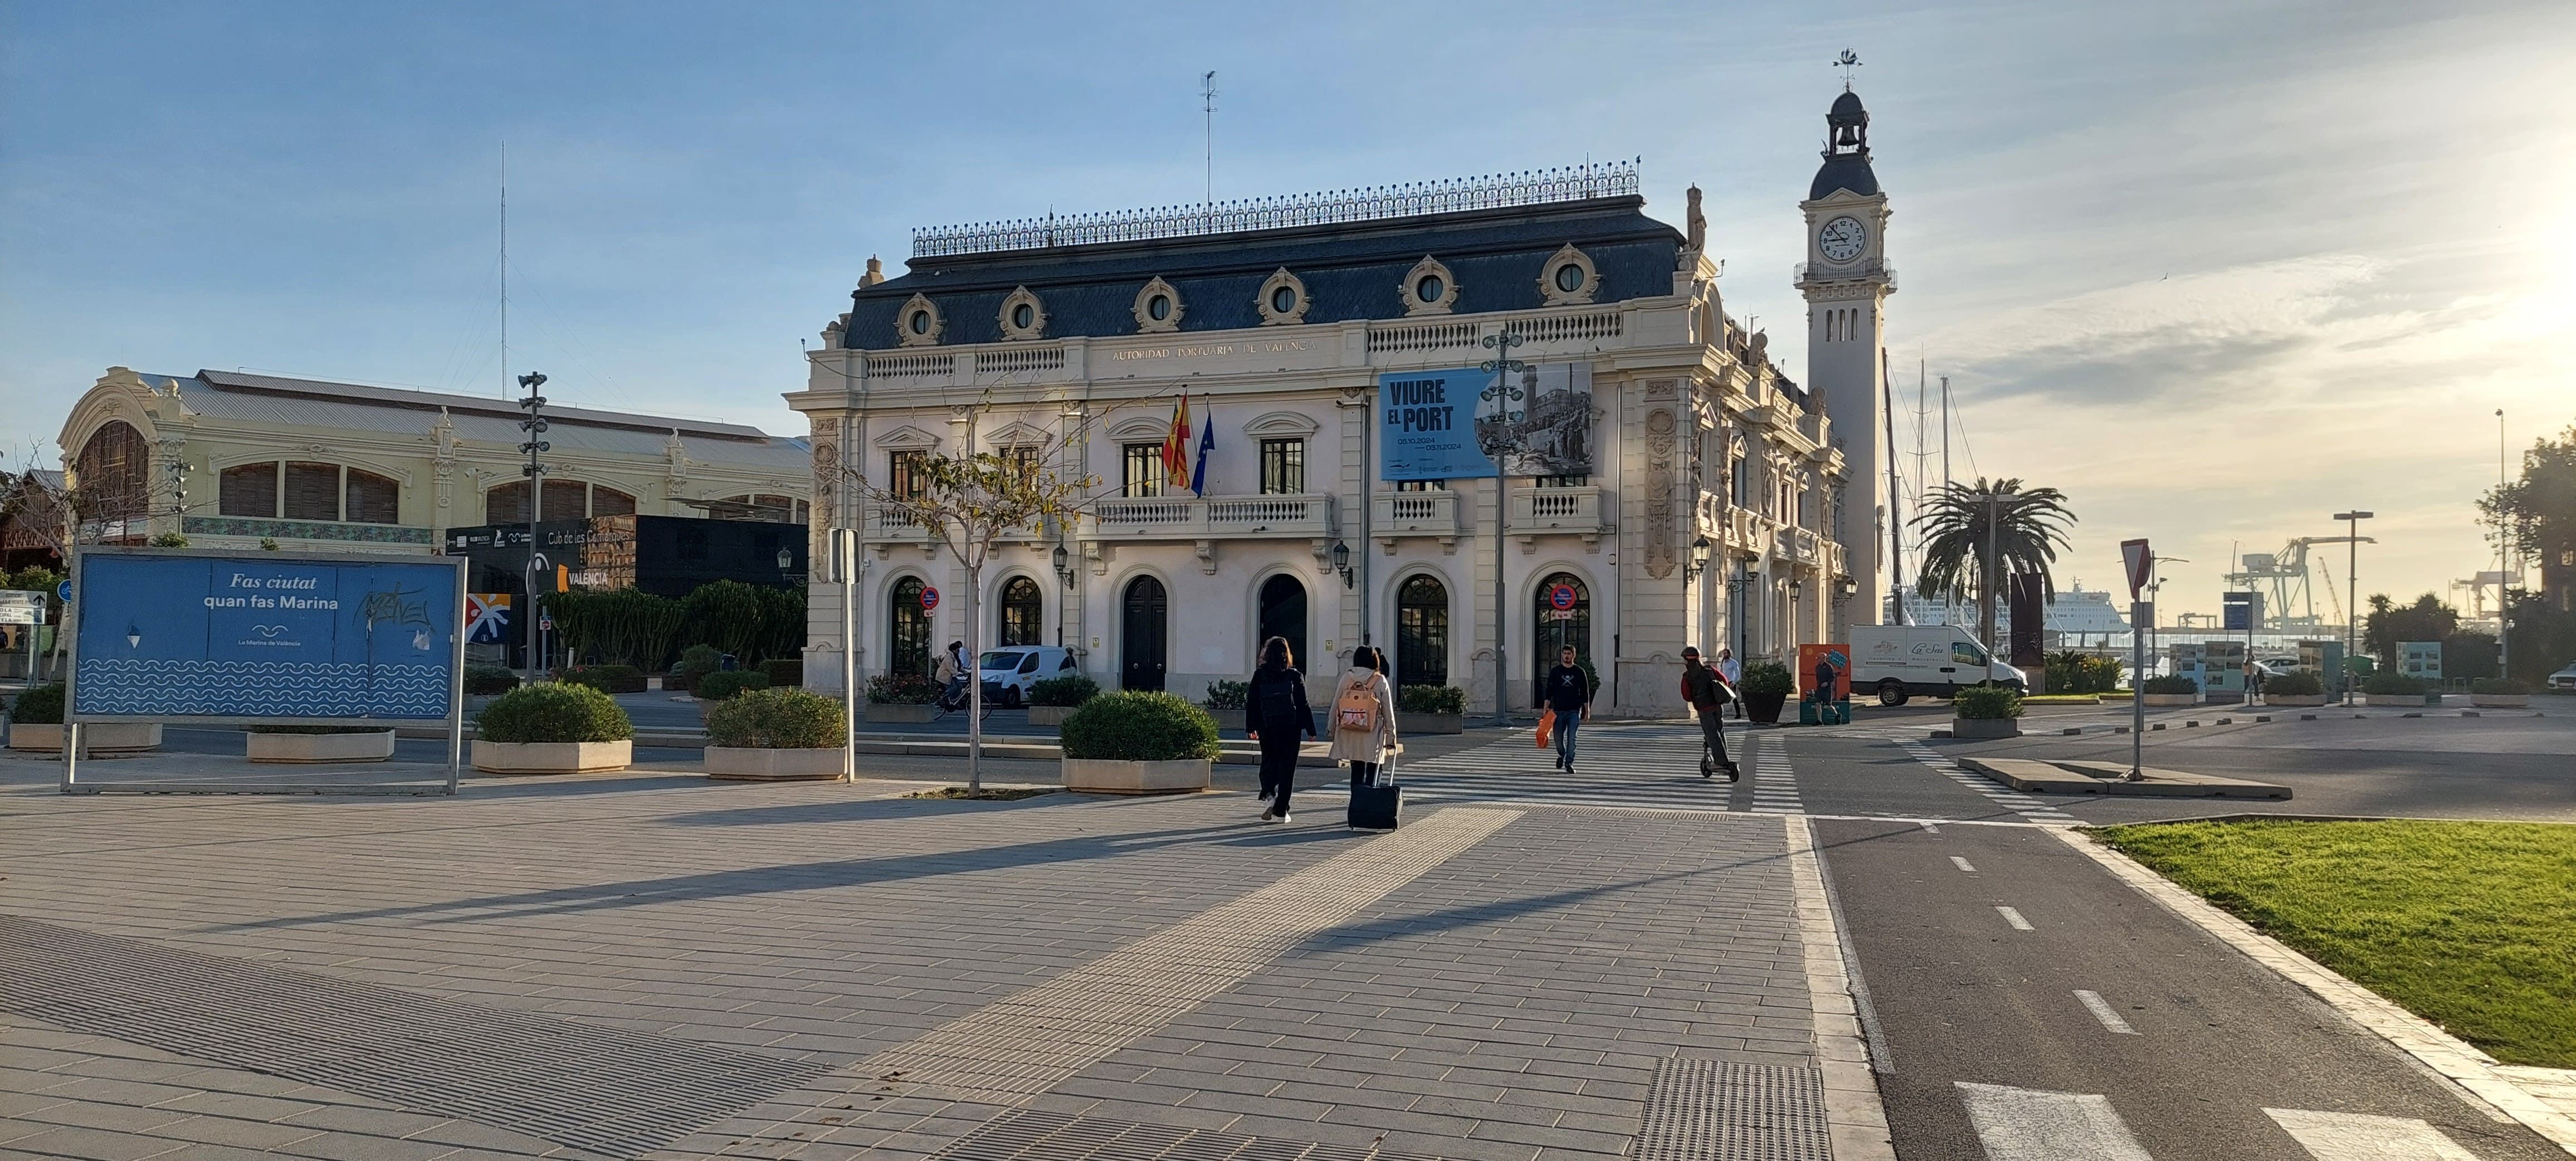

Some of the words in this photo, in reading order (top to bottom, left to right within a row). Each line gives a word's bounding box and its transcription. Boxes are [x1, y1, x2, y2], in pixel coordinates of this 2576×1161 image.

[1113, 349, 1170, 360] AUTORIDAD
[1177, 345, 1233, 357] PORTUARIA
[1243, 343, 1257, 353] DE
[1265, 341, 1317, 353] VALENCIA
[1389, 379, 1446, 406] VIURE
[1388, 409, 1401, 425] EL
[1403, 406, 1453, 432] PORT
[548, 531, 563, 544] Cub
[564, 530, 573, 543] de
[574, 530, 585, 544] les
[587, 530, 630, 545] Comarques
[230, 573, 262, 588] Fas
[266, 574, 318, 589] ciutat
[569, 570, 608, 585] VALÈNCIA
[204, 596, 246, 609] quan
[250, 595, 275, 608] fas
[280, 596, 338, 609] Marina
[1911, 642, 1926, 655] La
[1926, 644, 1944, 654] Seu
